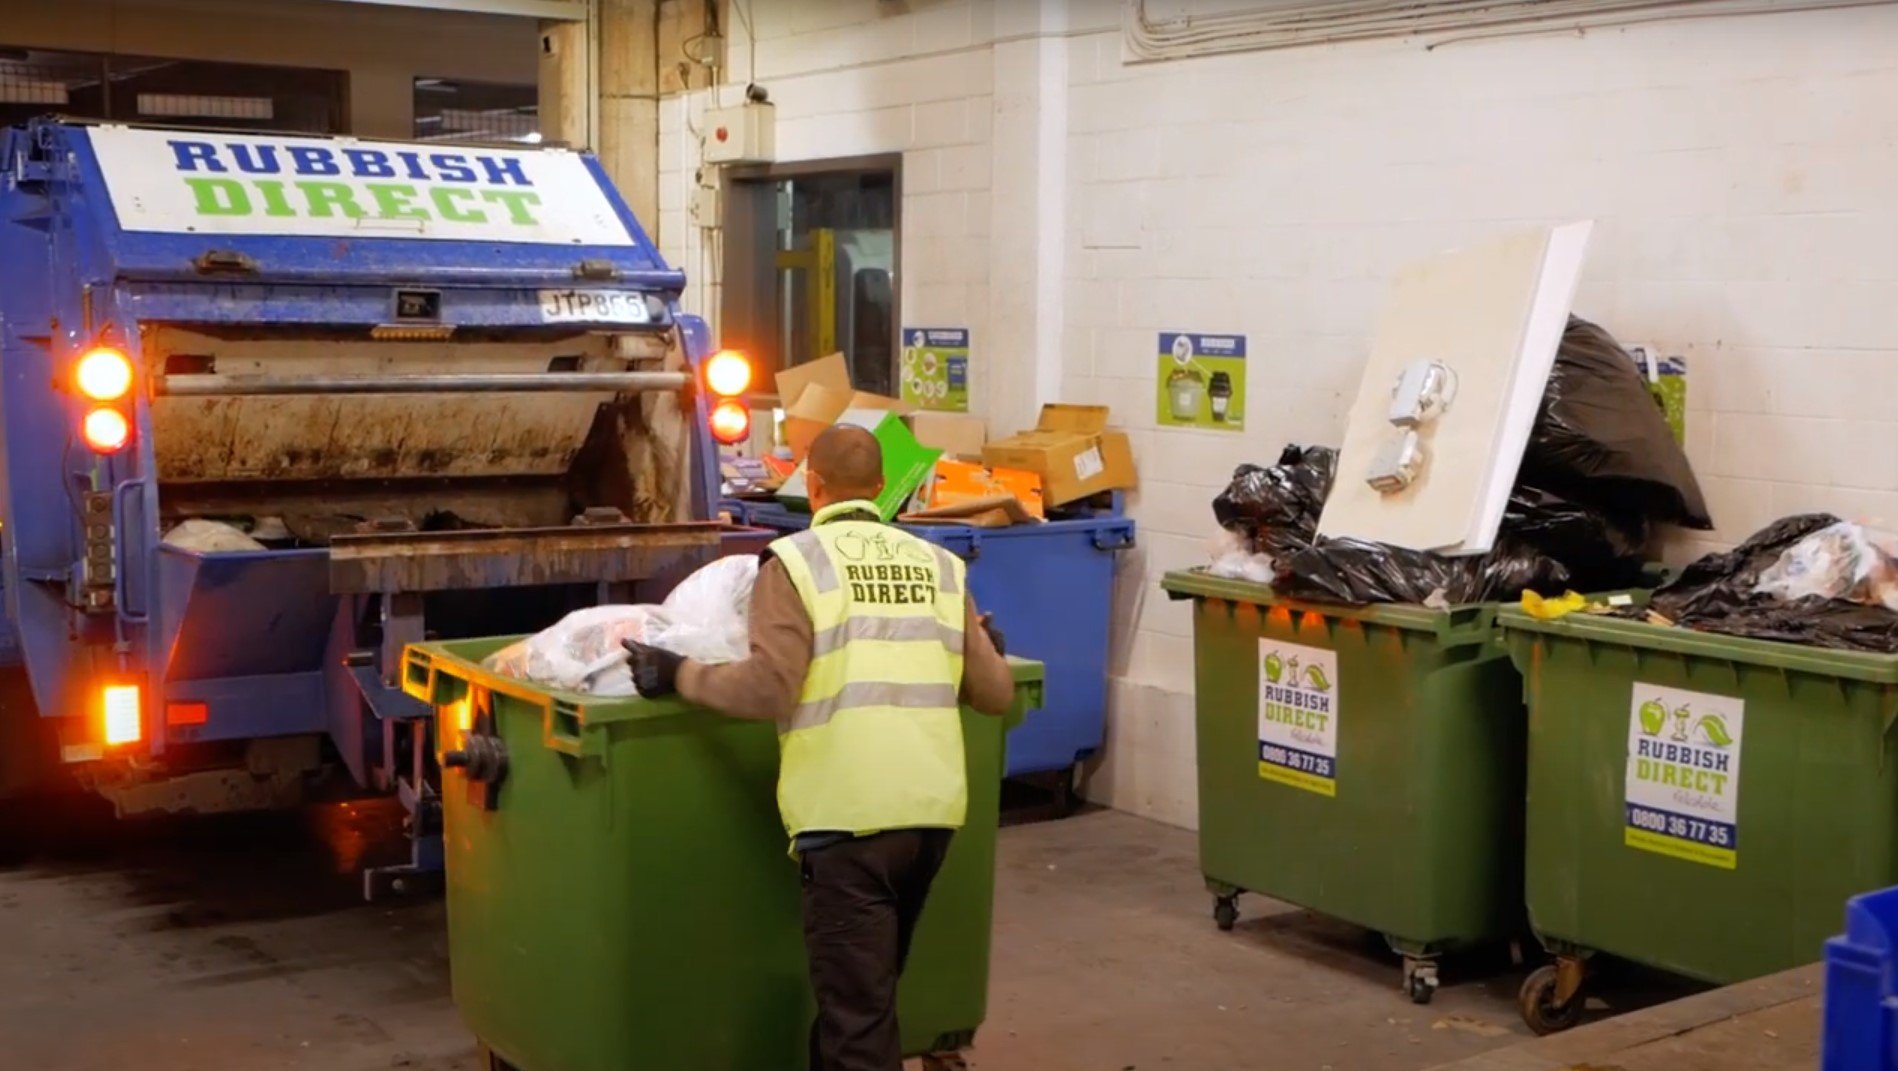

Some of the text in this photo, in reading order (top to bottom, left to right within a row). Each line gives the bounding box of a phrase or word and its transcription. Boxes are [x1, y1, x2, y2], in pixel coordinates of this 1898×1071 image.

[167, 140, 534, 186] RUBBISH
[184, 177, 542, 226] DIRECT
[851, 583, 936, 604] DIRECT
[1265, 686, 1329, 712] RUBBISH
[1265, 702, 1328, 731] DIRECT
[1301, 755, 1314, 771] 77
[1316, 759, 1329, 775] 35
[1638, 739, 1729, 771] RUBBISH
[1637, 759, 1727, 795] DIRECT
[1633, 809, 1728, 844] 0800 36 77 35
